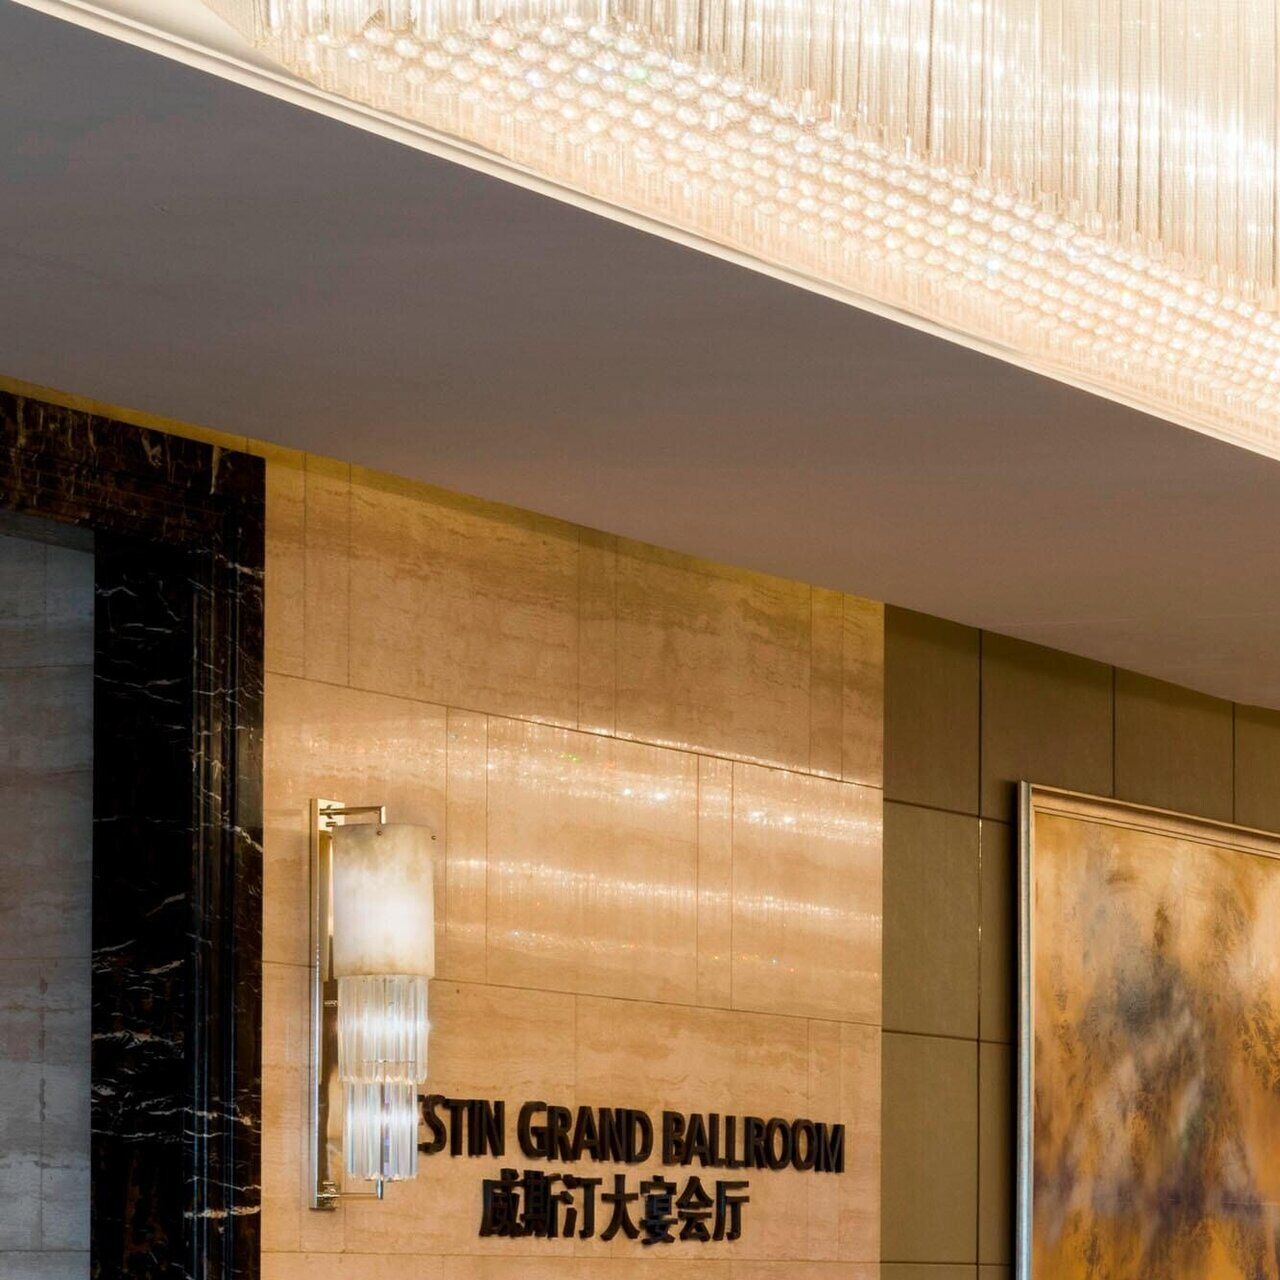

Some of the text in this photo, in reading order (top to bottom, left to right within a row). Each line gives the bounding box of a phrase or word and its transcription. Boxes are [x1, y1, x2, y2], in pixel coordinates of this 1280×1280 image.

[418, 1094, 845, 1173] STIN GRAND BALLROOM
[478, 1168, 750, 1246] 威斯汀大宴会厅
